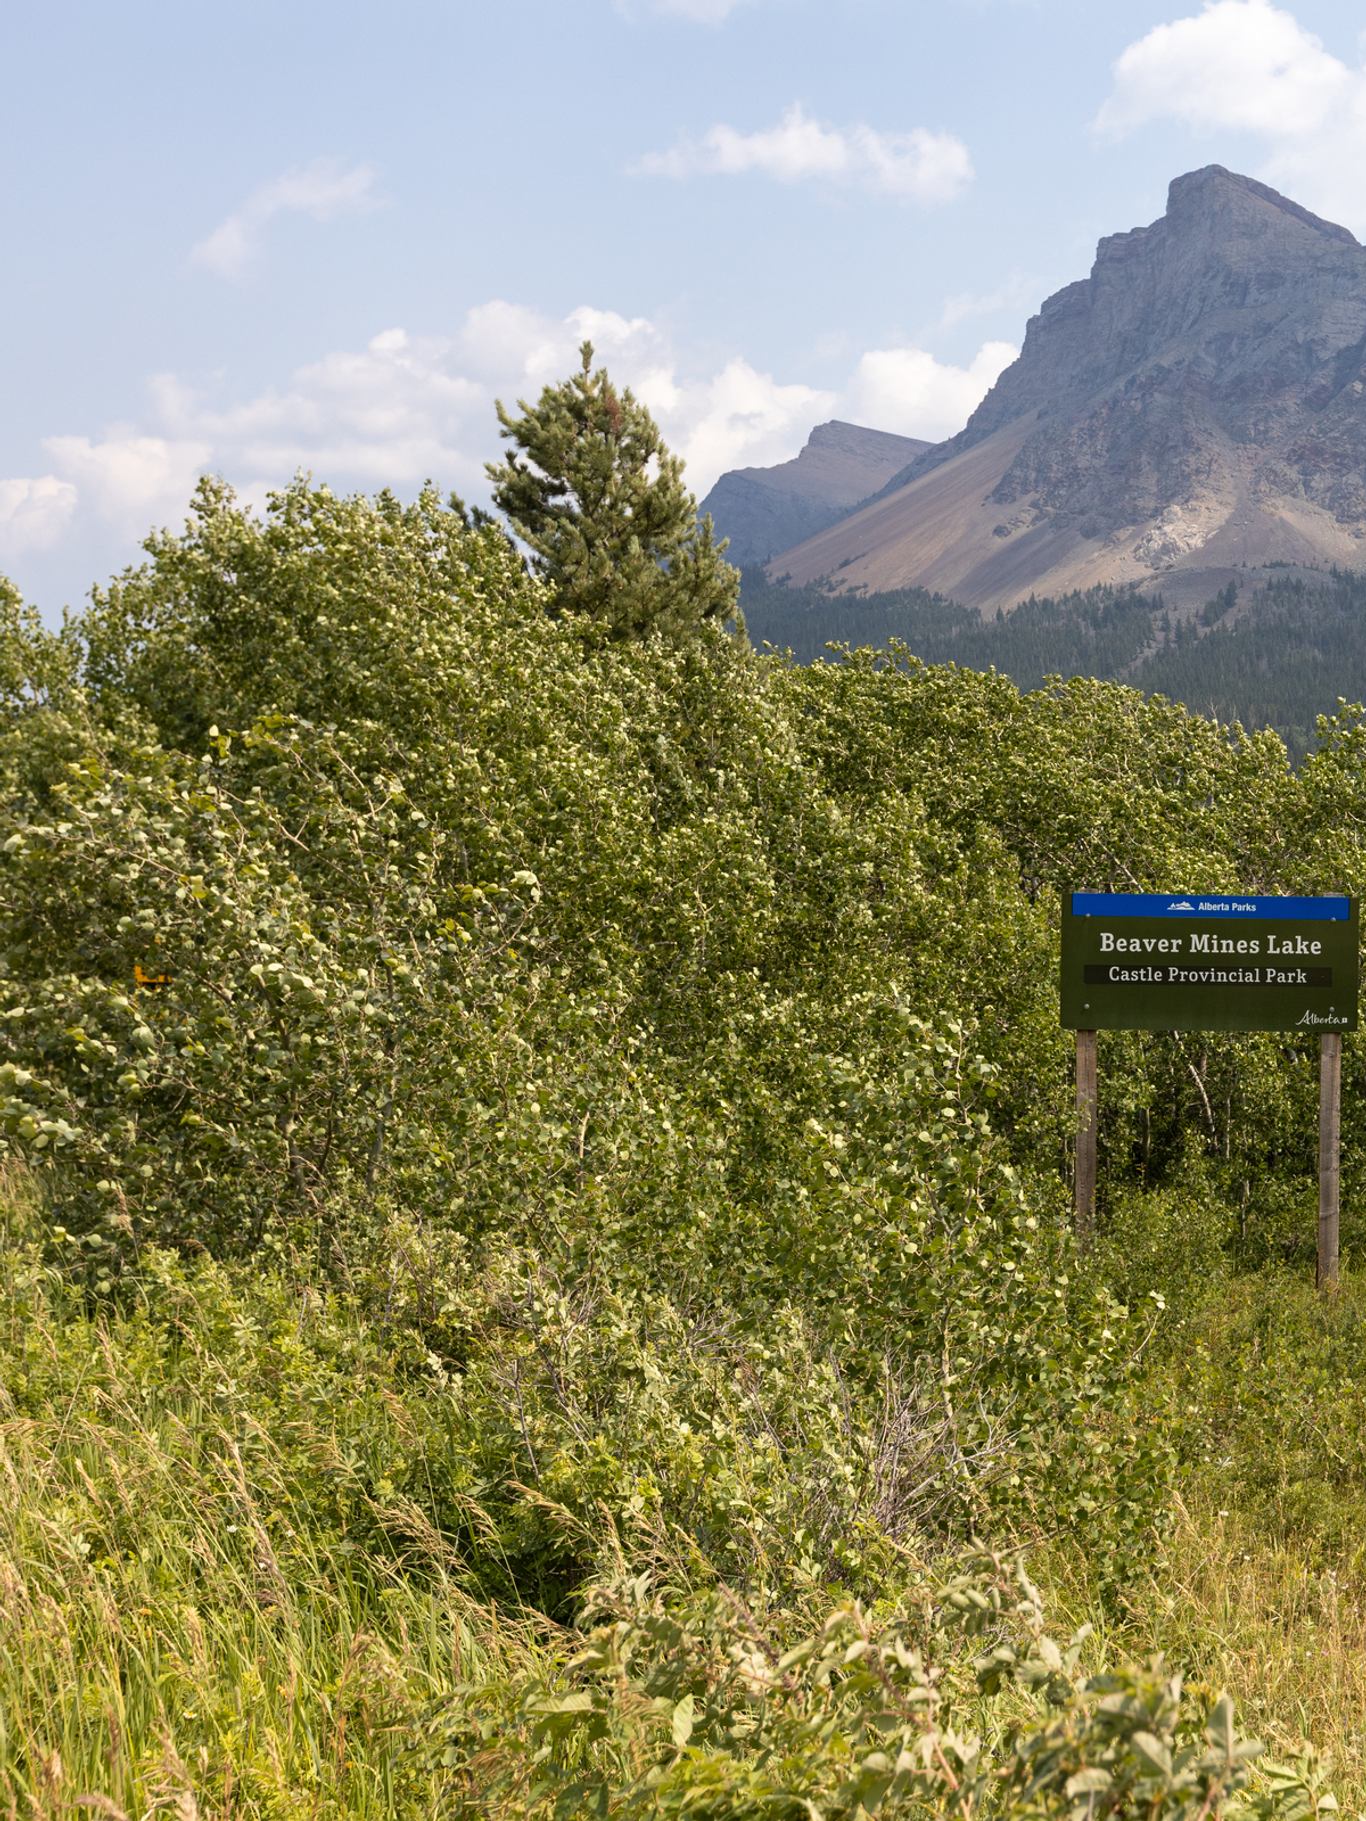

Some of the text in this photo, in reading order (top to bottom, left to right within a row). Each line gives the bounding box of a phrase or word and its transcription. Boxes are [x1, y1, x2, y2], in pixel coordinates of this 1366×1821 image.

[1198, 902, 1257, 912] Alberta Parks
[1100, 932, 1322, 955] Beaver Mines Lake
[1109, 966, 1307, 984] Castle Provincial Park
[1295, 1010, 1343, 1026] Alberta
